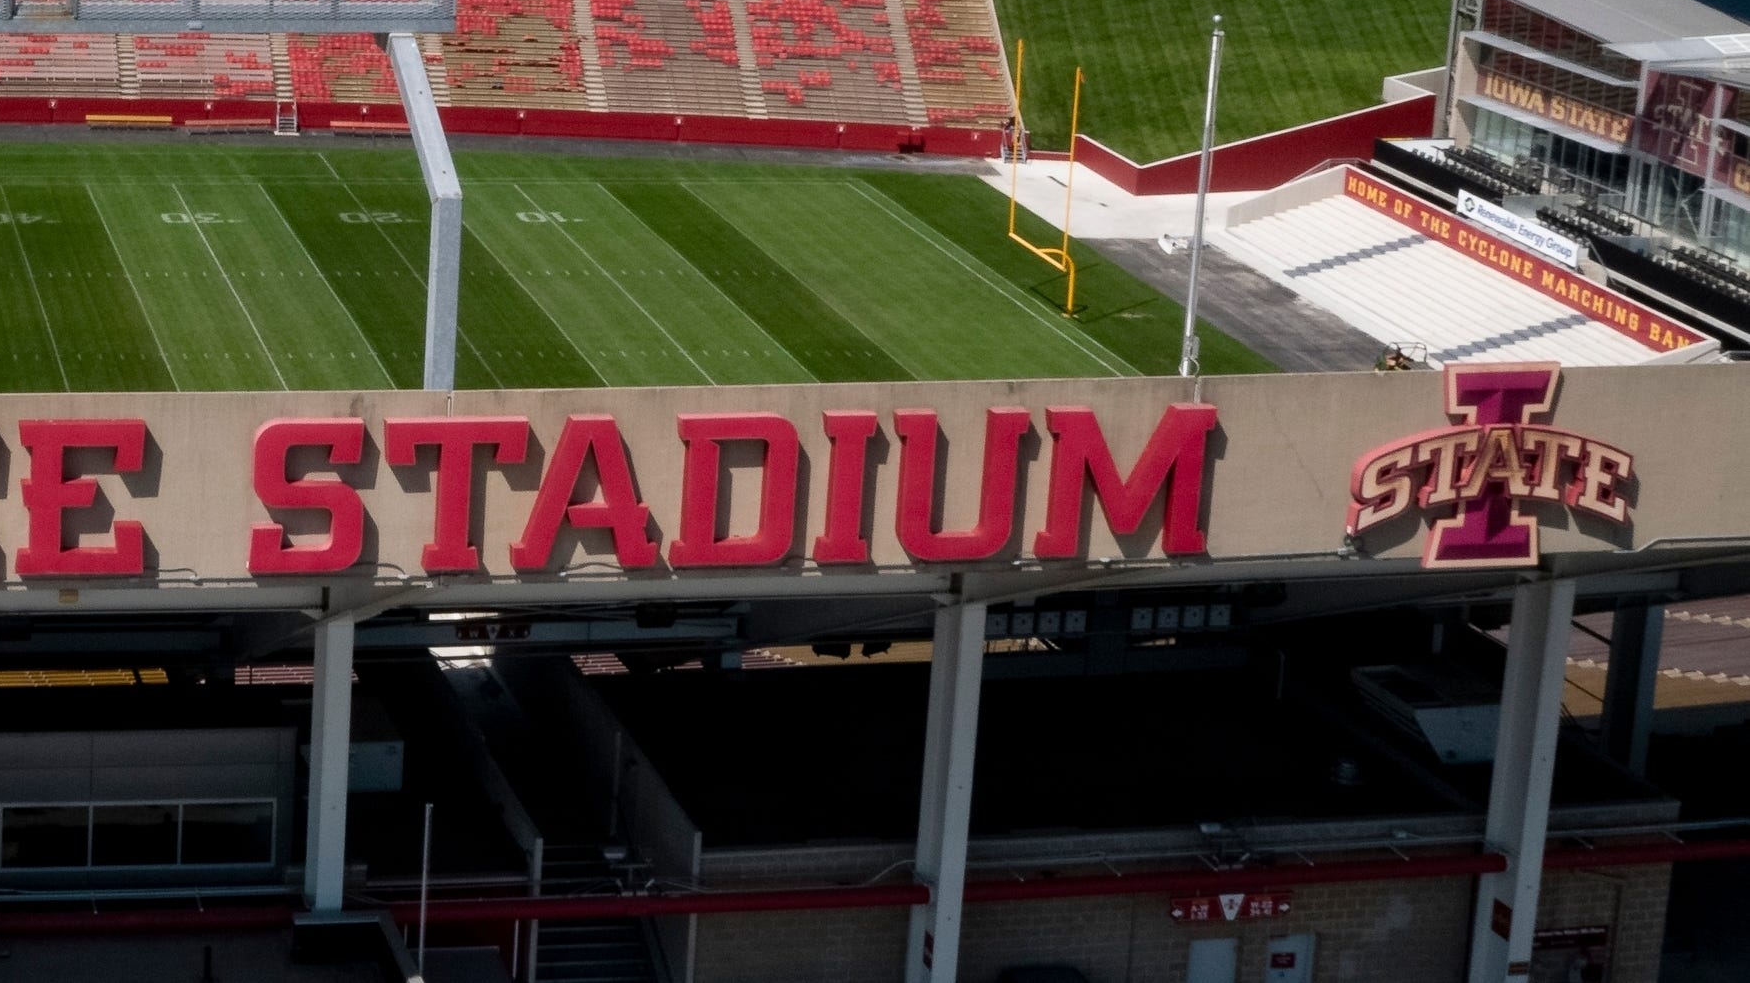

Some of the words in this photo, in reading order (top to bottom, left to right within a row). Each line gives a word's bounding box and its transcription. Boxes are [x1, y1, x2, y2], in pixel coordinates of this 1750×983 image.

[1484, 72, 1545, 114] IOWA
[1550, 94, 1630, 142] STATE
[1347, 175, 1389, 209] HOME
[1393, 198, 1414, 220] OF
[1419, 209, 1452, 240] THE
[1457, 228, 1534, 280] CYCLONE
[1540, 268, 1641, 332] MARCHING
[1648, 321, 1693, 349] BAN
[1476, 203, 1518, 233] Renewable
[1517, 223, 1546, 249] Energy
[1545, 236, 1573, 260] Group
[246, 403, 1219, 575] STADIUM
[1346, 424, 1635, 535] STATE
